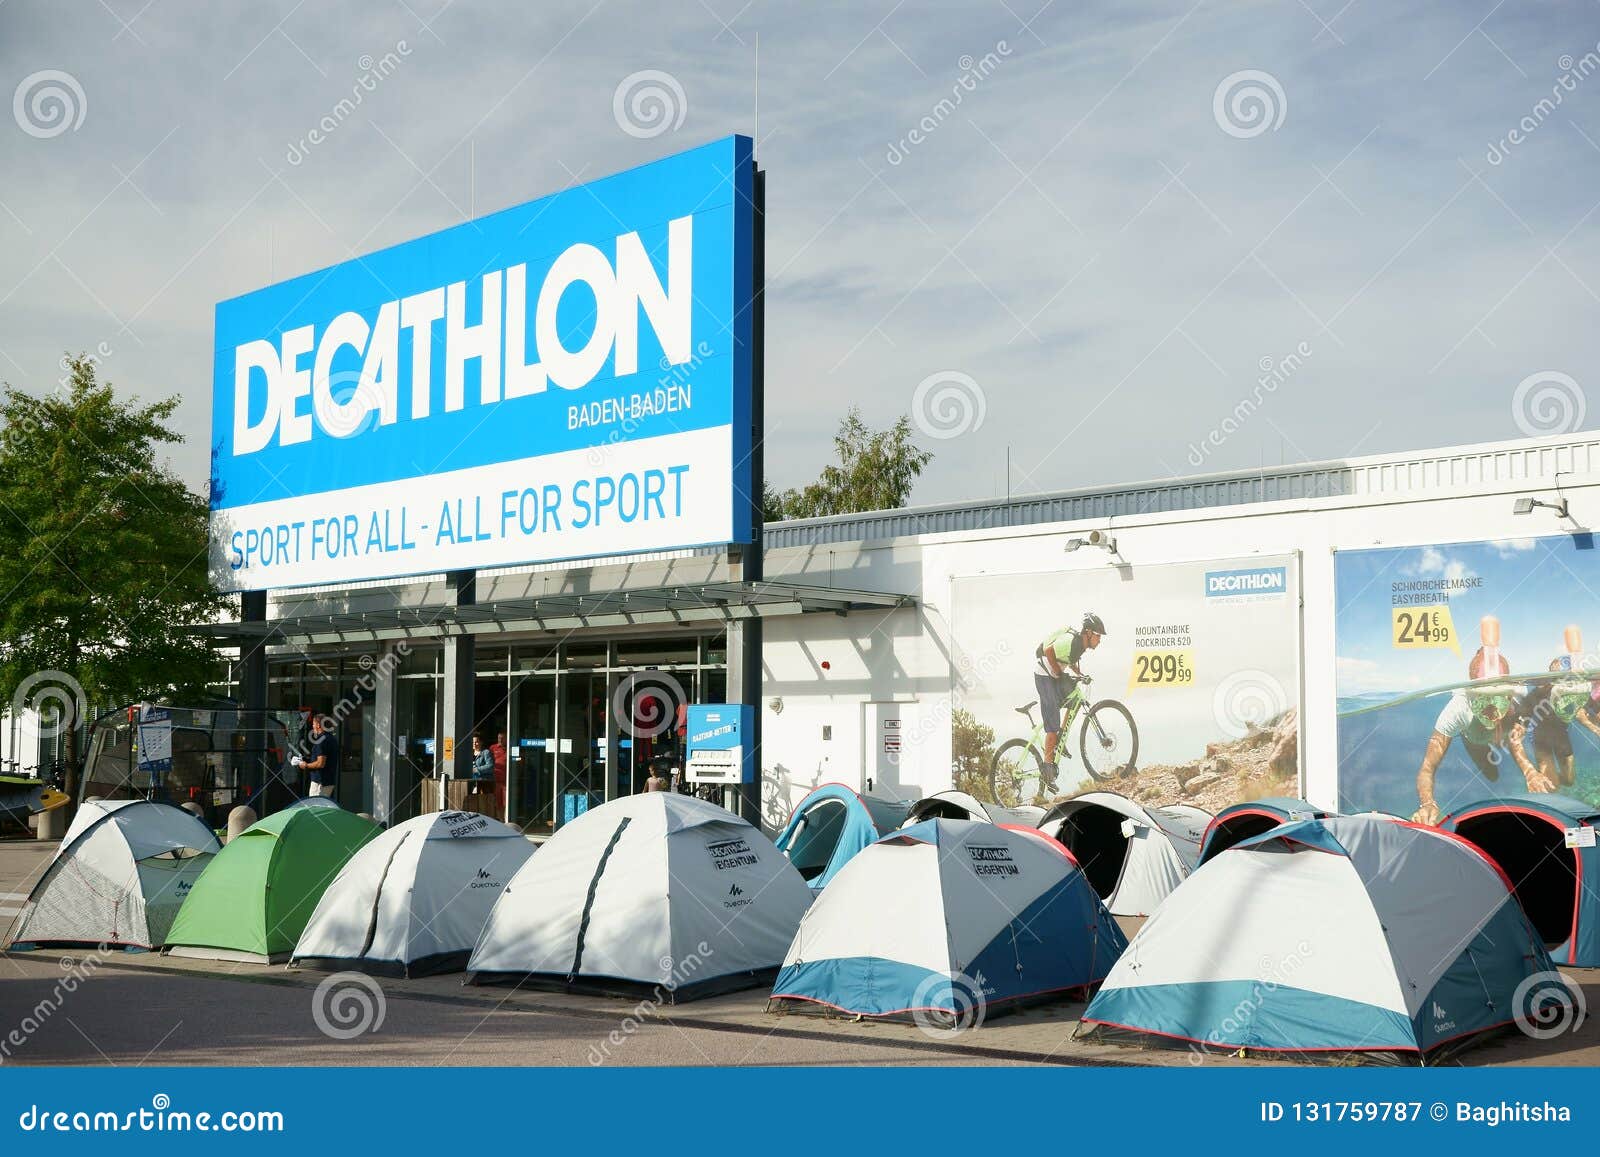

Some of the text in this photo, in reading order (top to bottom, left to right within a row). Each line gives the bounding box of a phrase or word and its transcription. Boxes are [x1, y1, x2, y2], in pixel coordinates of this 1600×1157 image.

[232, 214, 693, 457] DECATHLON
[567, 383, 692, 430] BADEN-BADEN
[230, 521, 305, 571] SPORT
[311, 514, 359, 561] FOR
[365, 506, 416, 554] ALL
[435, 495, 491, 546] ALL
[501, 484, 562, 538] FOR
[571, 464, 690, 529] SPORT
[1208, 572, 1282, 592] DECATHLON
[1392, 577, 1483, 592] SCHNORCHELMASKE
[1392, 592, 1449, 605] EASYBREATH
[1135, 624, 1190, 635] MOUNTAINBIKE
[1135, 637, 1176, 647] ROCKRIDER
[451, 819, 488, 838] EIGENTUM
[716, 854, 758, 870] EIGENTUM
[975, 864, 1020, 876] EIGENTUM
